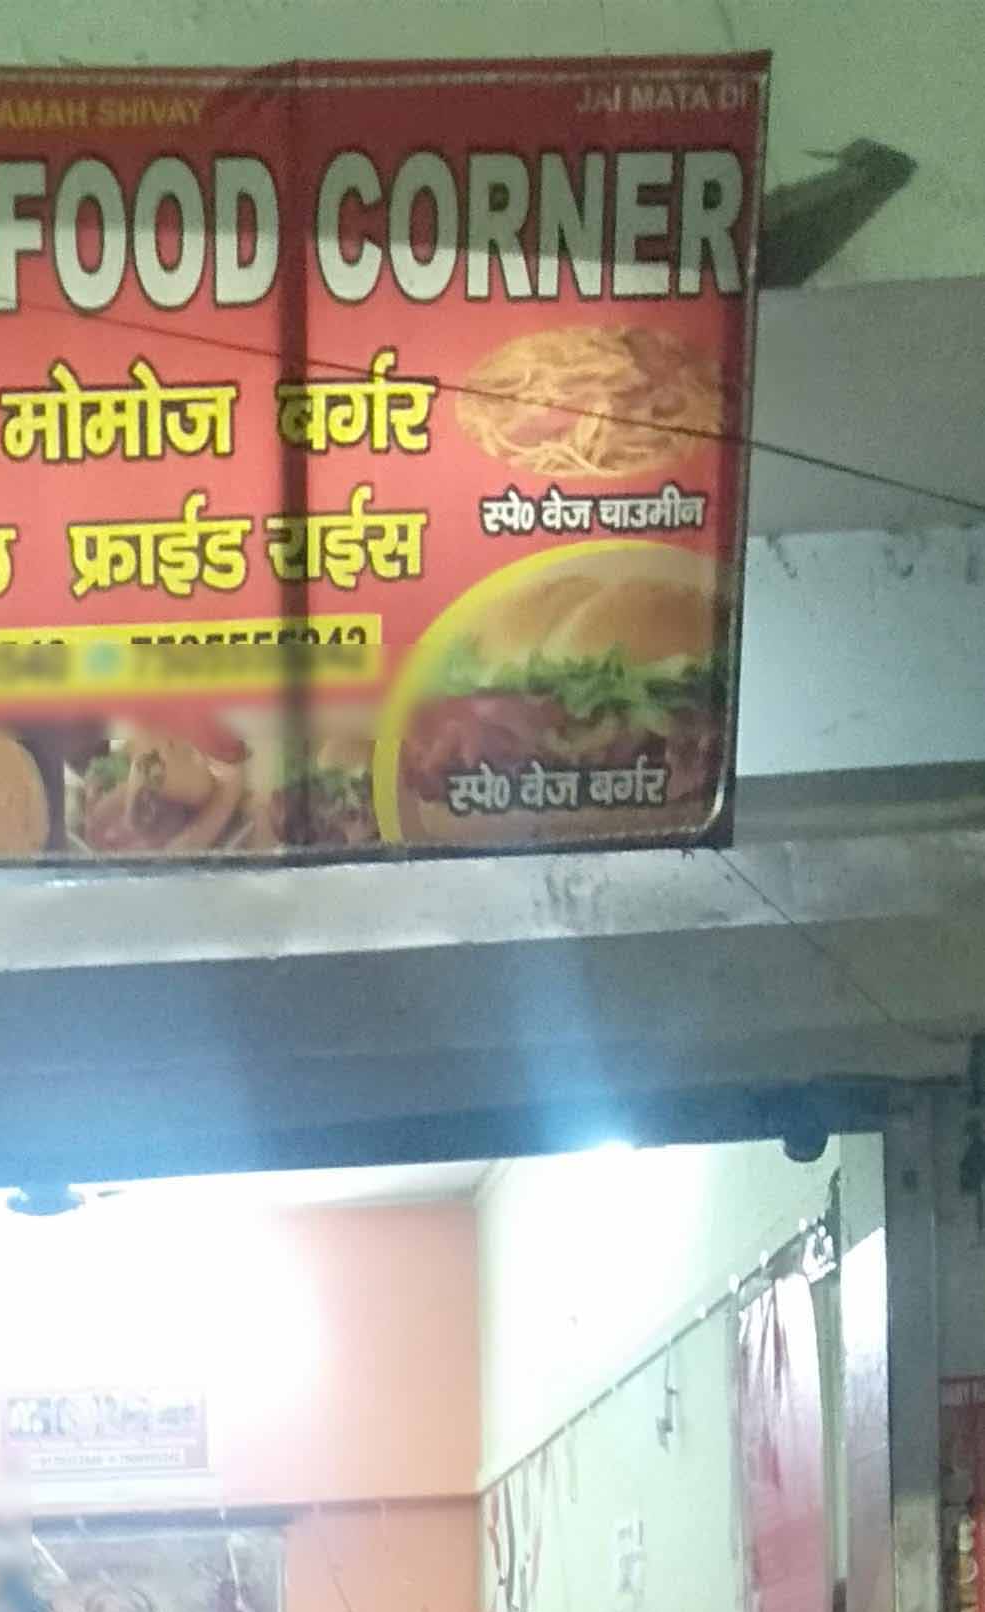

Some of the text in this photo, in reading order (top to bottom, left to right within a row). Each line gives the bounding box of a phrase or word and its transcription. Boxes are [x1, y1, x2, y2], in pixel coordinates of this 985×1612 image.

[98, 97, 203, 125] SHIVAY
[577, 83, 748, 113] JAI MATA DI
[316, 148, 745, 303] CORNER
[277, 351, 437, 453] बर्गर
[540, 486, 594, 531] वेज
[598, 483, 707, 530] चाउमीन
[68, 488, 251, 597] फ्राईड
[267, 484, 428, 594] राईस
[519, 759, 580, 808] वेज
[588, 754, 668, 806] बर्गर
